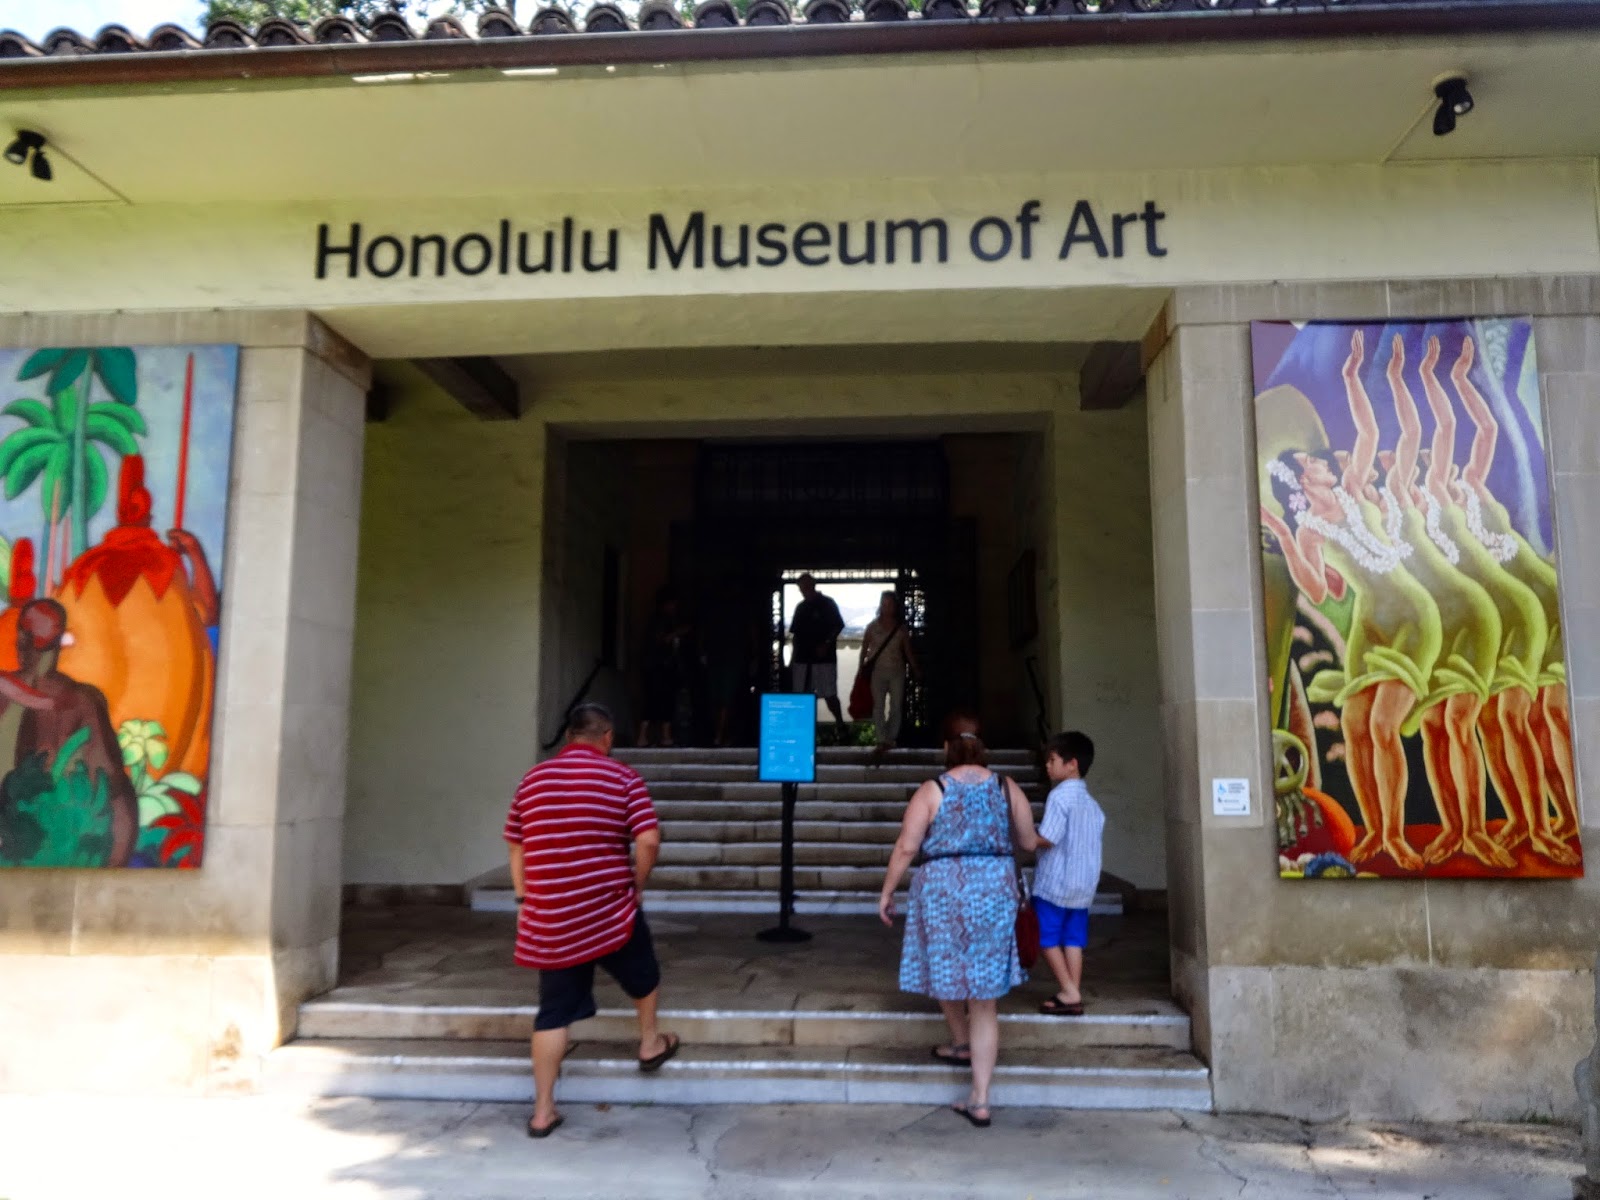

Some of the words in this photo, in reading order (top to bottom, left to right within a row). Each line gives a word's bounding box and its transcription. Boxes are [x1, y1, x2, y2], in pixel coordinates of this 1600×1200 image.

[315, 216, 620, 280] Honolulu
[648, 210, 948, 270] Museum
[969, 199, 1042, 262] of
[1058, 199, 1168, 260] Art
